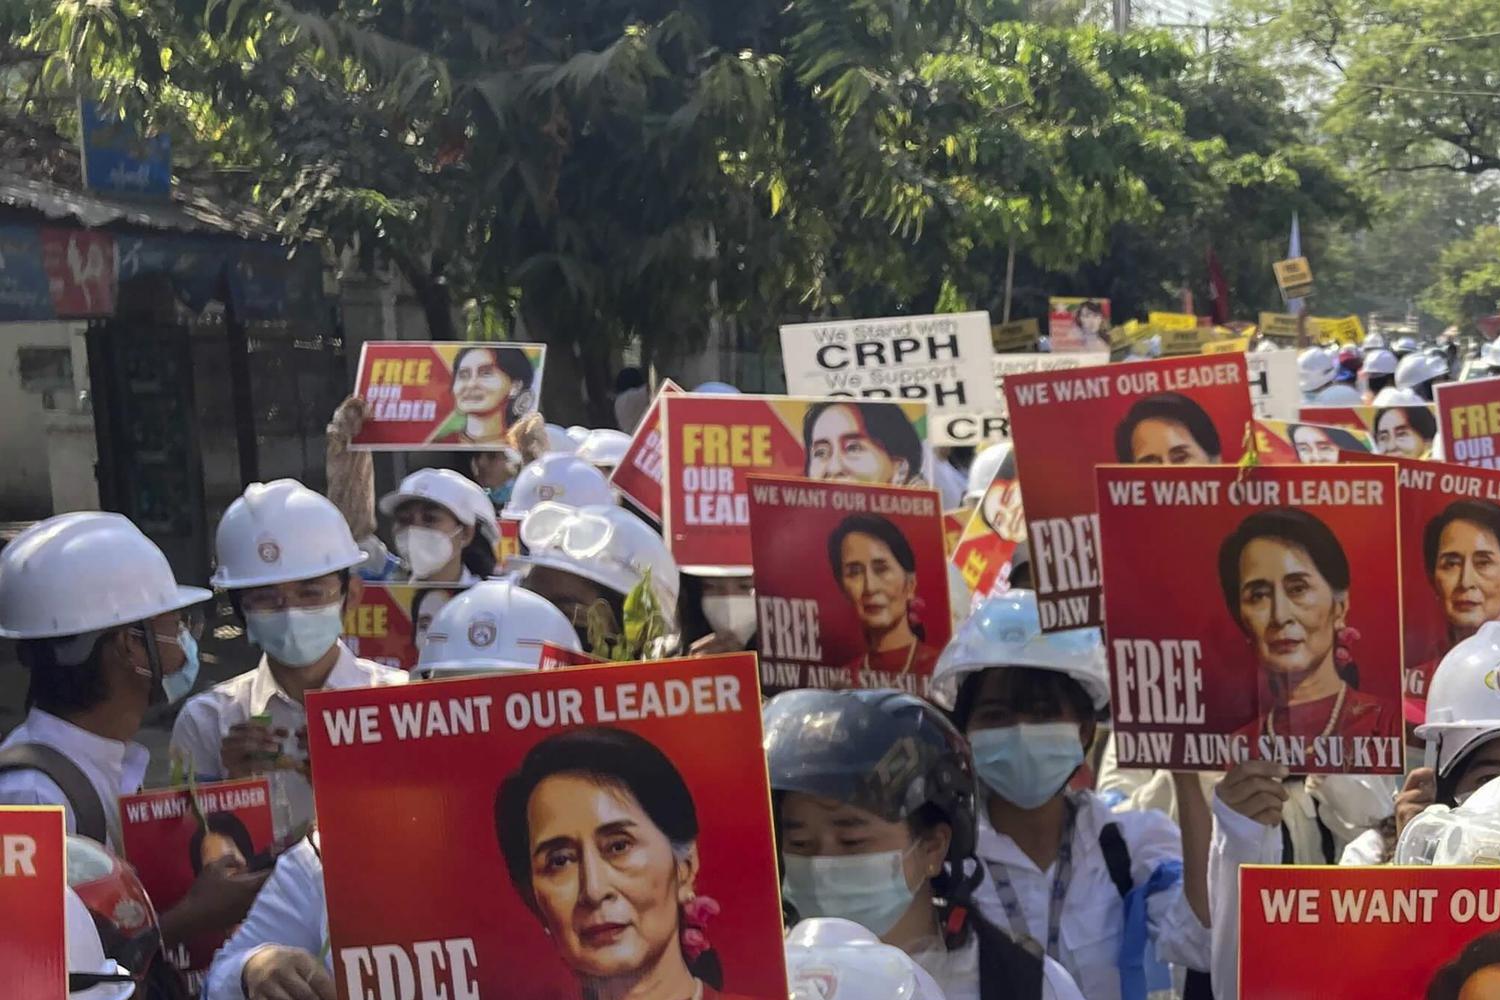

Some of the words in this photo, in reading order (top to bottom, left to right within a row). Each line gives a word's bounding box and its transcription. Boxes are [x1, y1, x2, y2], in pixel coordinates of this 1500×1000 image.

[814, 327, 847, 343] We
[855, 320, 912, 338] Stand
[816, 334, 960, 369] CRPH
[370, 359, 432, 385] FREE
[825, 373, 862, 389] We
[870, 366, 957, 386] Support
[1014, 383, 1049, 407] WE
[1053, 376, 1110, 401] WANT
[1116, 372, 1160, 396] OUR
[1163, 363, 1241, 391] LEADER
[366, 384, 402, 400] OUR
[682, 424, 772, 467] FREE
[1454, 436, 1494, 461] OUR
[683, 466, 734, 493] OUR
[1108, 481, 1146, 506] WE
[1151, 481, 1220, 505] WANT
[1228, 480, 1281, 505] OUR
[1287, 480, 1384, 505] LEADER
[1399, 468, 1436, 491] ANT
[1440, 475, 1482, 498] OUR
[684, 493, 750, 526] LEAD
[753, 485, 778, 505] WE
[782, 487, 827, 509] WANT
[832, 492, 866, 511] OUR
[870, 496, 936, 517] LEADER
[1029, 513, 1100, 594] FRE
[758, 596, 822, 661] FREE
[1039, 596, 1091, 630] DAW
[762, 661, 800, 688] DAW
[1113, 639, 1205, 724] FREE
[323, 706, 382, 746] WE
[389, 696, 494, 740] WANT
[505, 687, 584, 730] OUR
[594, 675, 742, 724] LEADER
[1116, 732, 1174, 764] DAW
[1183, 733, 1248, 765] AUNG
[1258, 735, 1306, 766] SAN
[1314, 736, 1346, 767] SU
[1353, 736, 1401, 768] KYI
[127, 803, 149, 824] WE
[151, 797, 188, 820] WANT
[190, 792, 218, 813] UR
[219, 787, 266, 810] LEADER
[1259, 888, 1320, 924] WE
[1331, 888, 1439, 923] WANT
